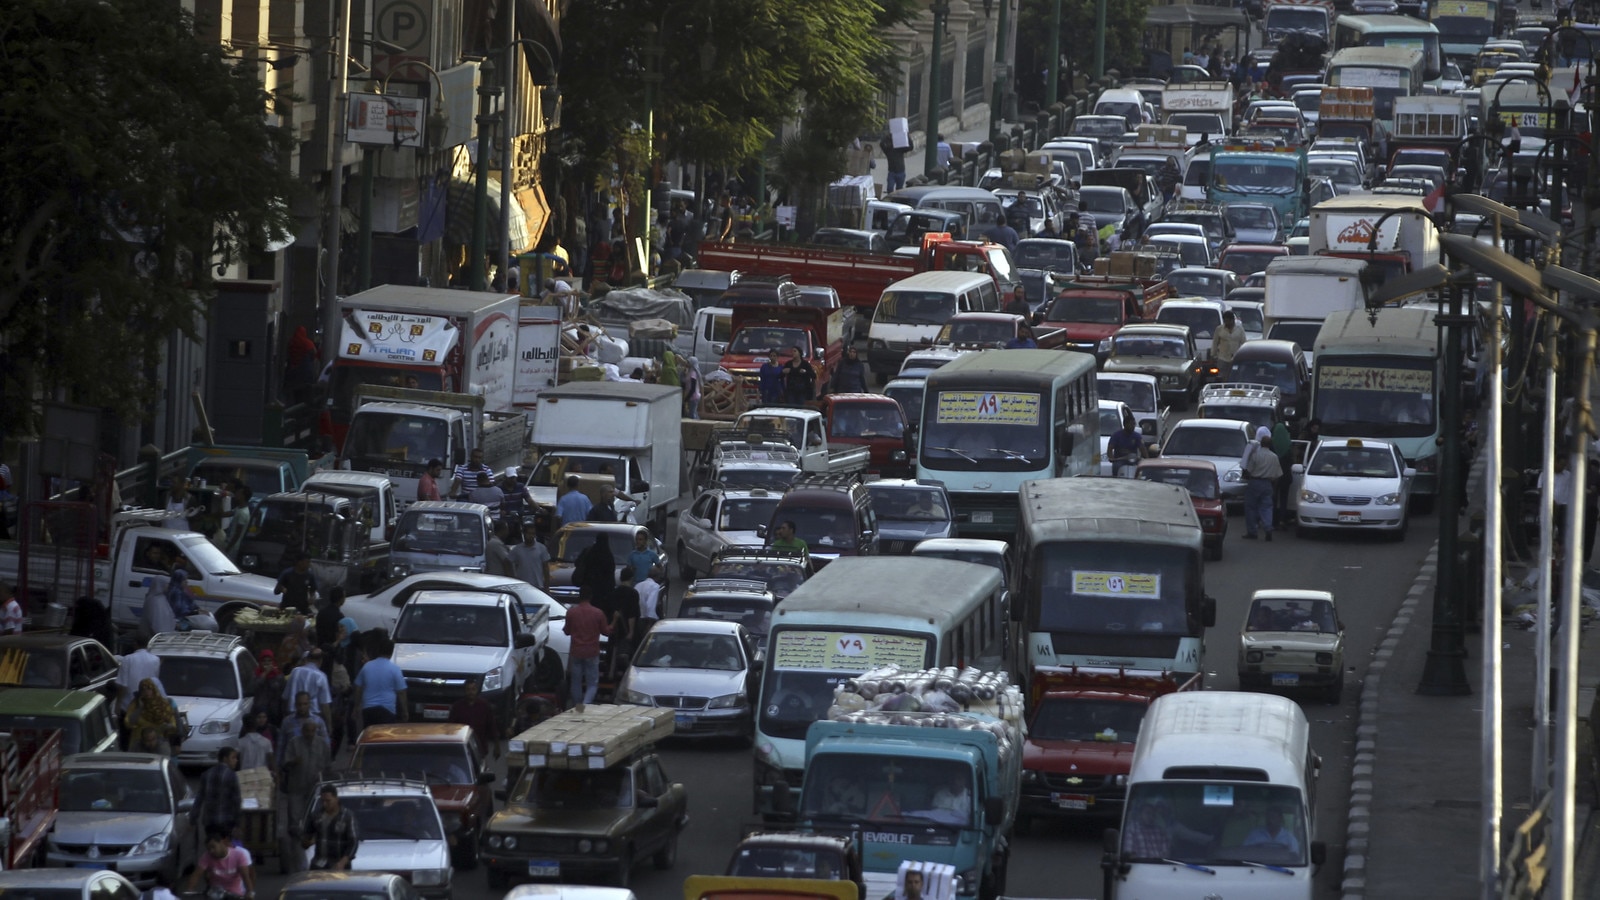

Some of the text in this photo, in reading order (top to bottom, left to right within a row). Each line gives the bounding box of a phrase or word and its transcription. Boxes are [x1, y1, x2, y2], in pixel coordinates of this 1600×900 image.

[393, 11, 415, 41] P
[978, 394, 998, 414] ٨٩
[839, 638, 863, 651] ٧٩
[1181, 648, 1198, 664] ١٨٩
[852, 831, 914, 844] CEVROLET
